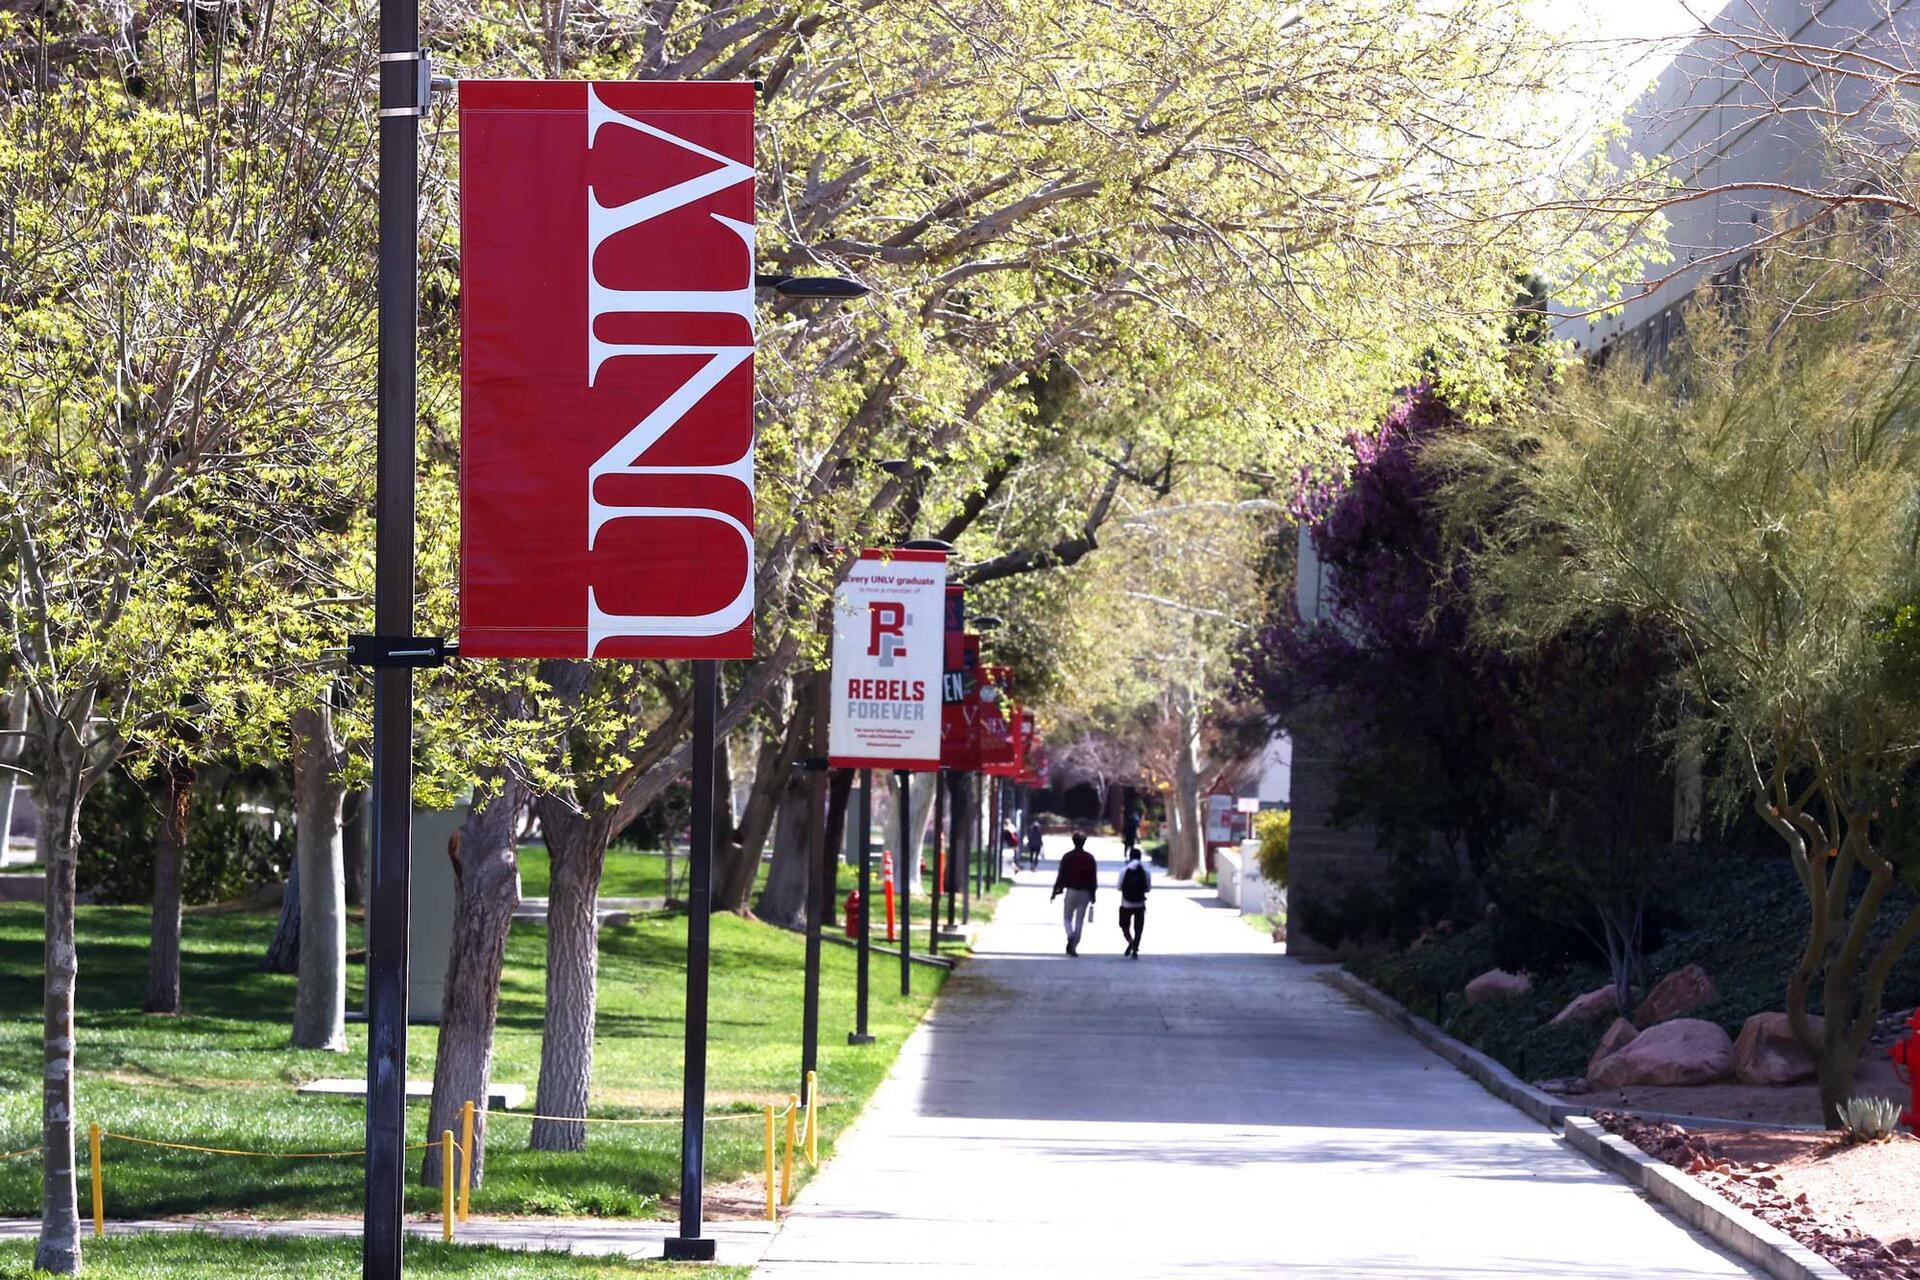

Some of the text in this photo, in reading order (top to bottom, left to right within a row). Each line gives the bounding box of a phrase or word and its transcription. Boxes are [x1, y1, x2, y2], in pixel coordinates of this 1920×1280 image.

[588, 82, 755, 658] UNLV
[870, 575, 895, 584] UNLV
[896, 576, 935, 586] graduate
[848, 678, 925, 702] REBELS
[847, 702, 925, 721] FOREVER
